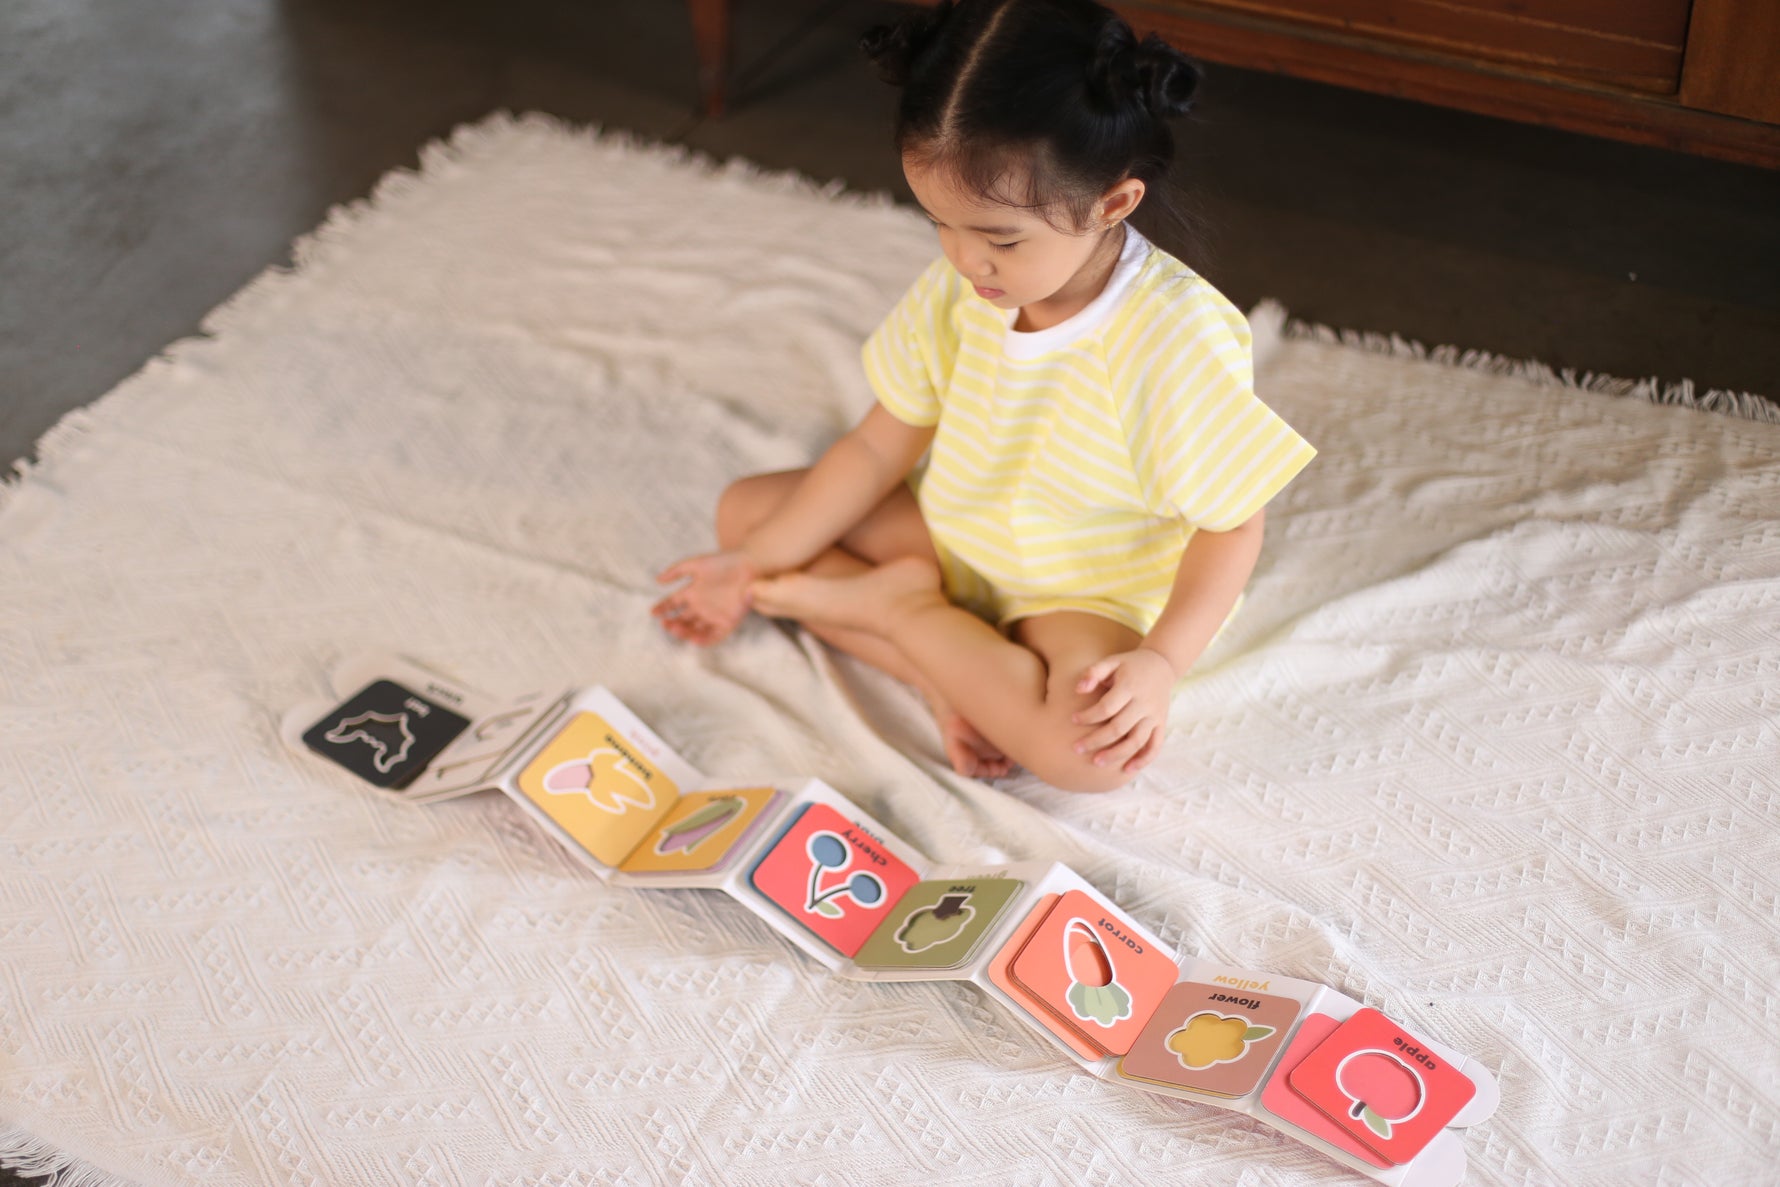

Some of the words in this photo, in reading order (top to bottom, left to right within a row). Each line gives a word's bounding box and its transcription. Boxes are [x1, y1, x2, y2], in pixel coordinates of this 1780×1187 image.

[841, 829, 888, 866] cherry
[947, 884, 977, 894] tree
[1098, 917, 1144, 955] carrot
[1213, 975, 1271, 992] yellow
[1208, 992, 1261, 1010] flower
[1393, 1036, 1437, 1071] apple
